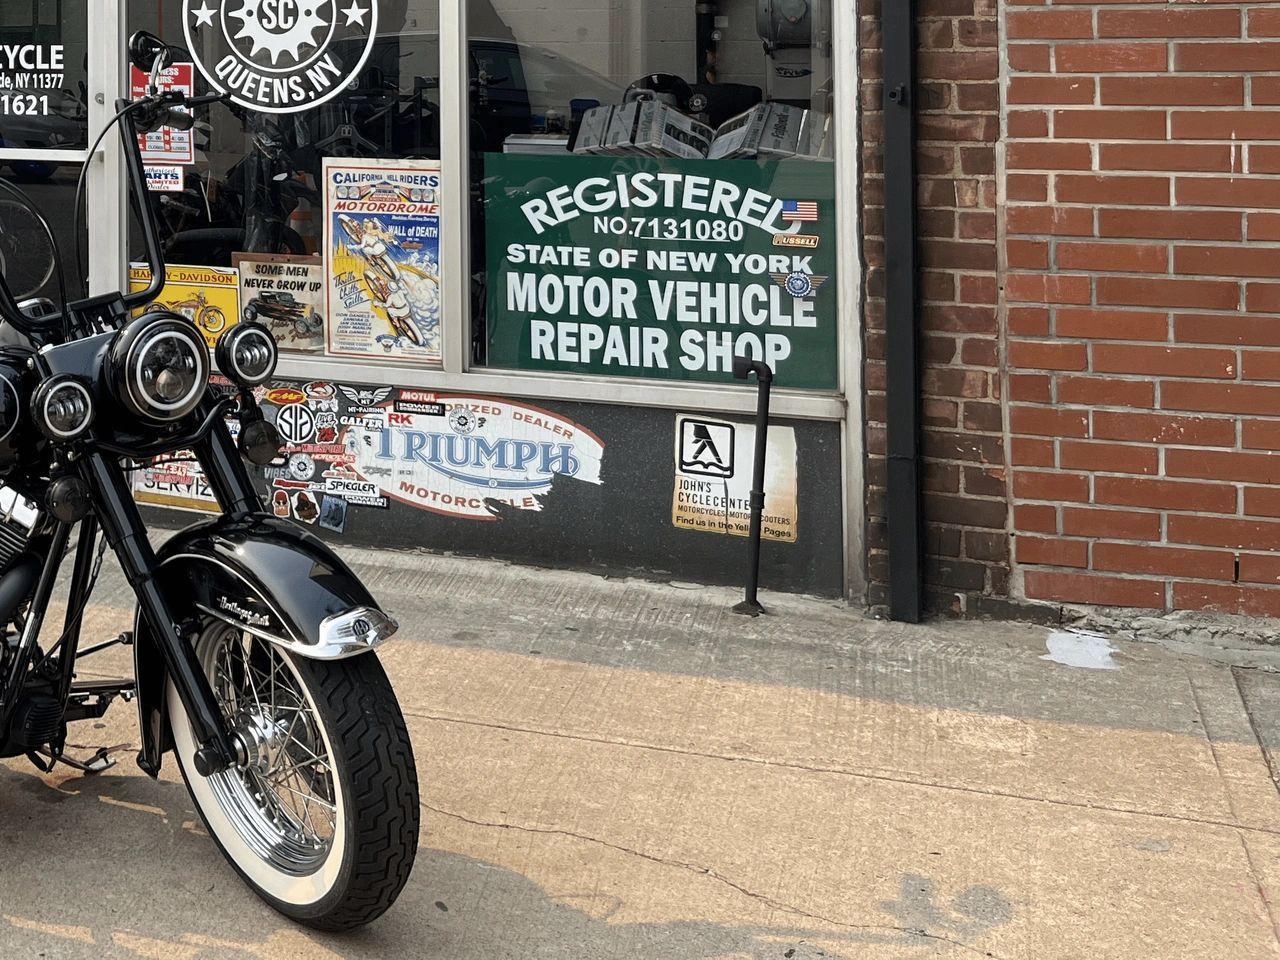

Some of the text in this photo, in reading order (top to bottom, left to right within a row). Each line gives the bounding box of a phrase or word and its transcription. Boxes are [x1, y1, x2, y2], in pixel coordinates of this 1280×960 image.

[15, 73, 30, 89] NY
[32, 73, 64, 89] 11377
[144, 172, 179, 180] ARTS
[332, 172, 383, 185] CALIFORNIA
[399, 174, 439, 188] RIDERS
[334, 201, 439, 214] MOTORDROME
[520, 172, 802, 238] REGISTERED
[388, 225, 438, 238] WALL of DEATH
[506, 243, 814, 275] STATE OF NEW YORK
[255, 264, 309, 278] SOME MEN
[243, 277, 322, 292] NEVER GROW UP
[506, 271, 638, 320] MOTOR
[648, 279, 817, 328] VEHICLE
[530, 320, 792, 375] REPAIR SHOP
[400, 391, 436, 402] MOTUL
[399, 402, 440, 411] POWER
[339, 416, 384, 428] GALFER
[388, 413, 414, 425] RK
[512, 411, 574, 440] DEALER
[375, 427, 581, 477] TRIUMPH
[327, 480, 377, 494] SPIEGLER
[678, 479, 712, 494] JOHN'S
[676, 515, 695, 526] Find
[695, 519, 706, 527] us
[718, 521, 734, 530] the
[734, 522, 749, 532] Yell
[763, 526, 792, 538] Pages
